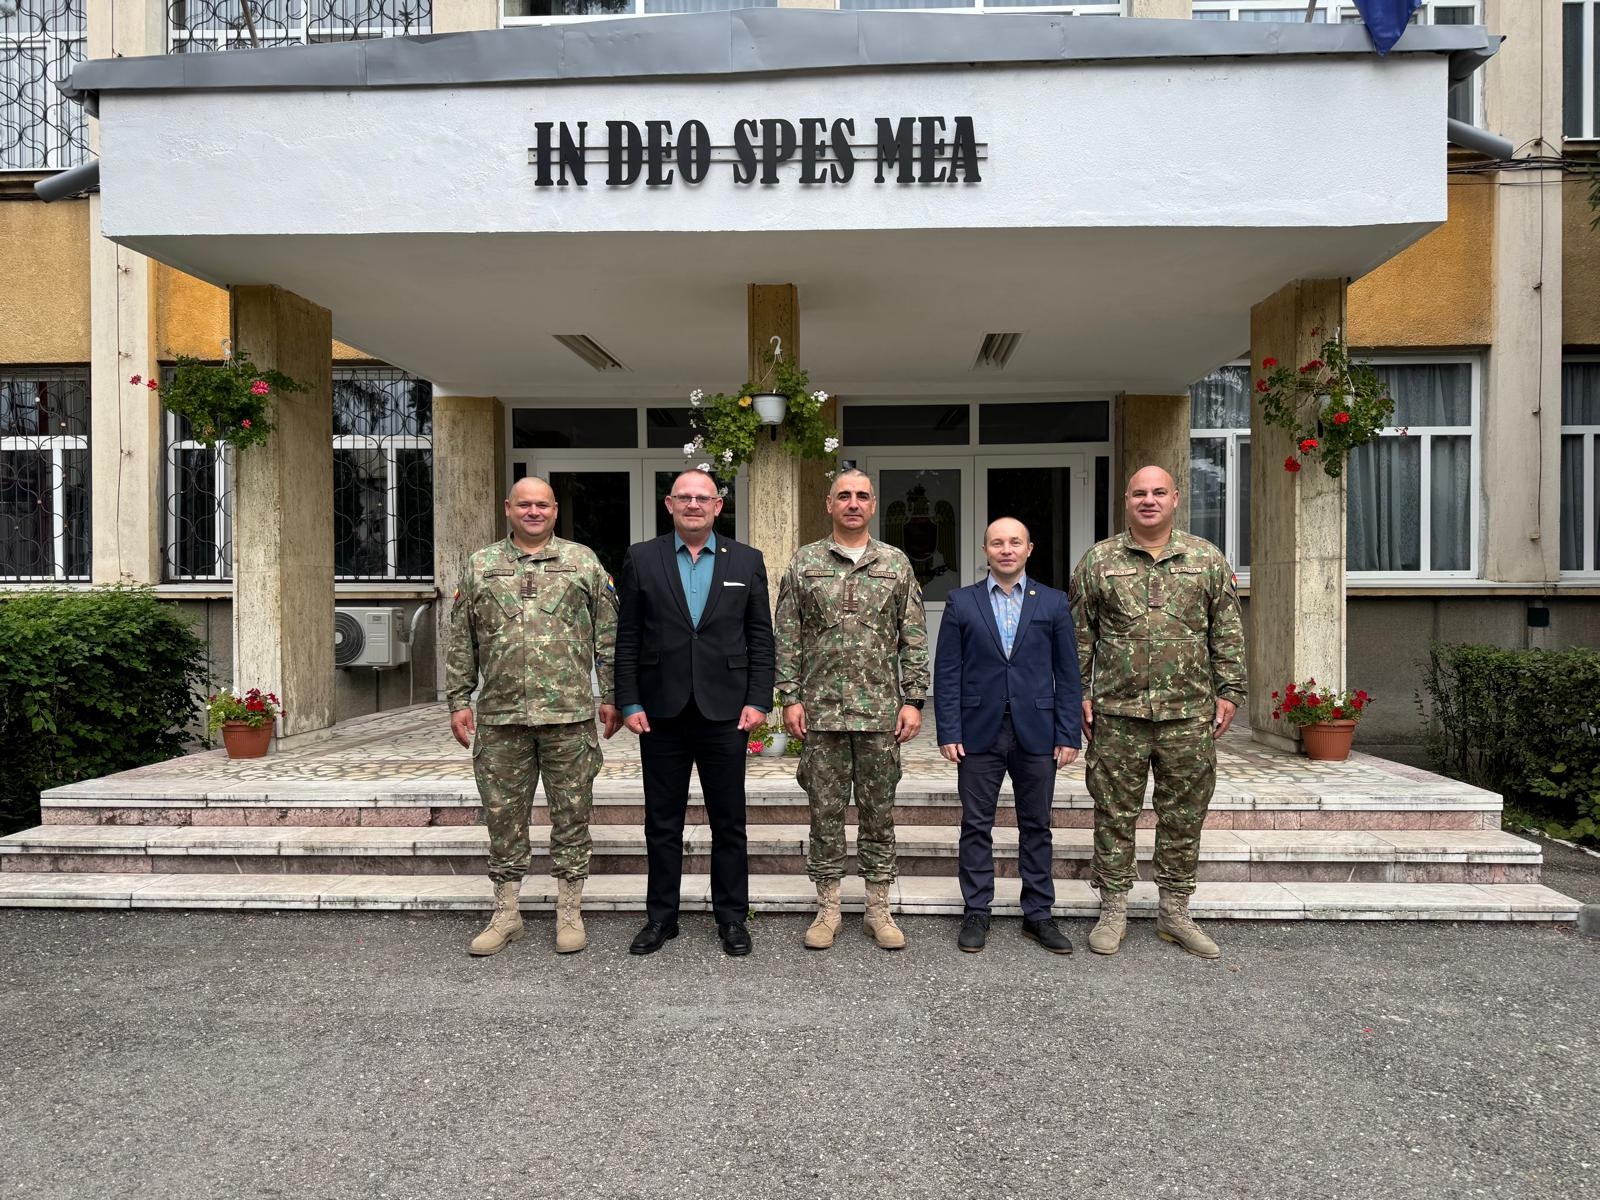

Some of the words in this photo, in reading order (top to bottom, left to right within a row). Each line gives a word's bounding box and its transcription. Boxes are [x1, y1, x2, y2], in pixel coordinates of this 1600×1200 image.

[534, 121, 588, 187] IN
[605, 119, 711, 186] DEO
[733, 118, 855, 184] SPES
[874, 116, 982, 184] MEA
